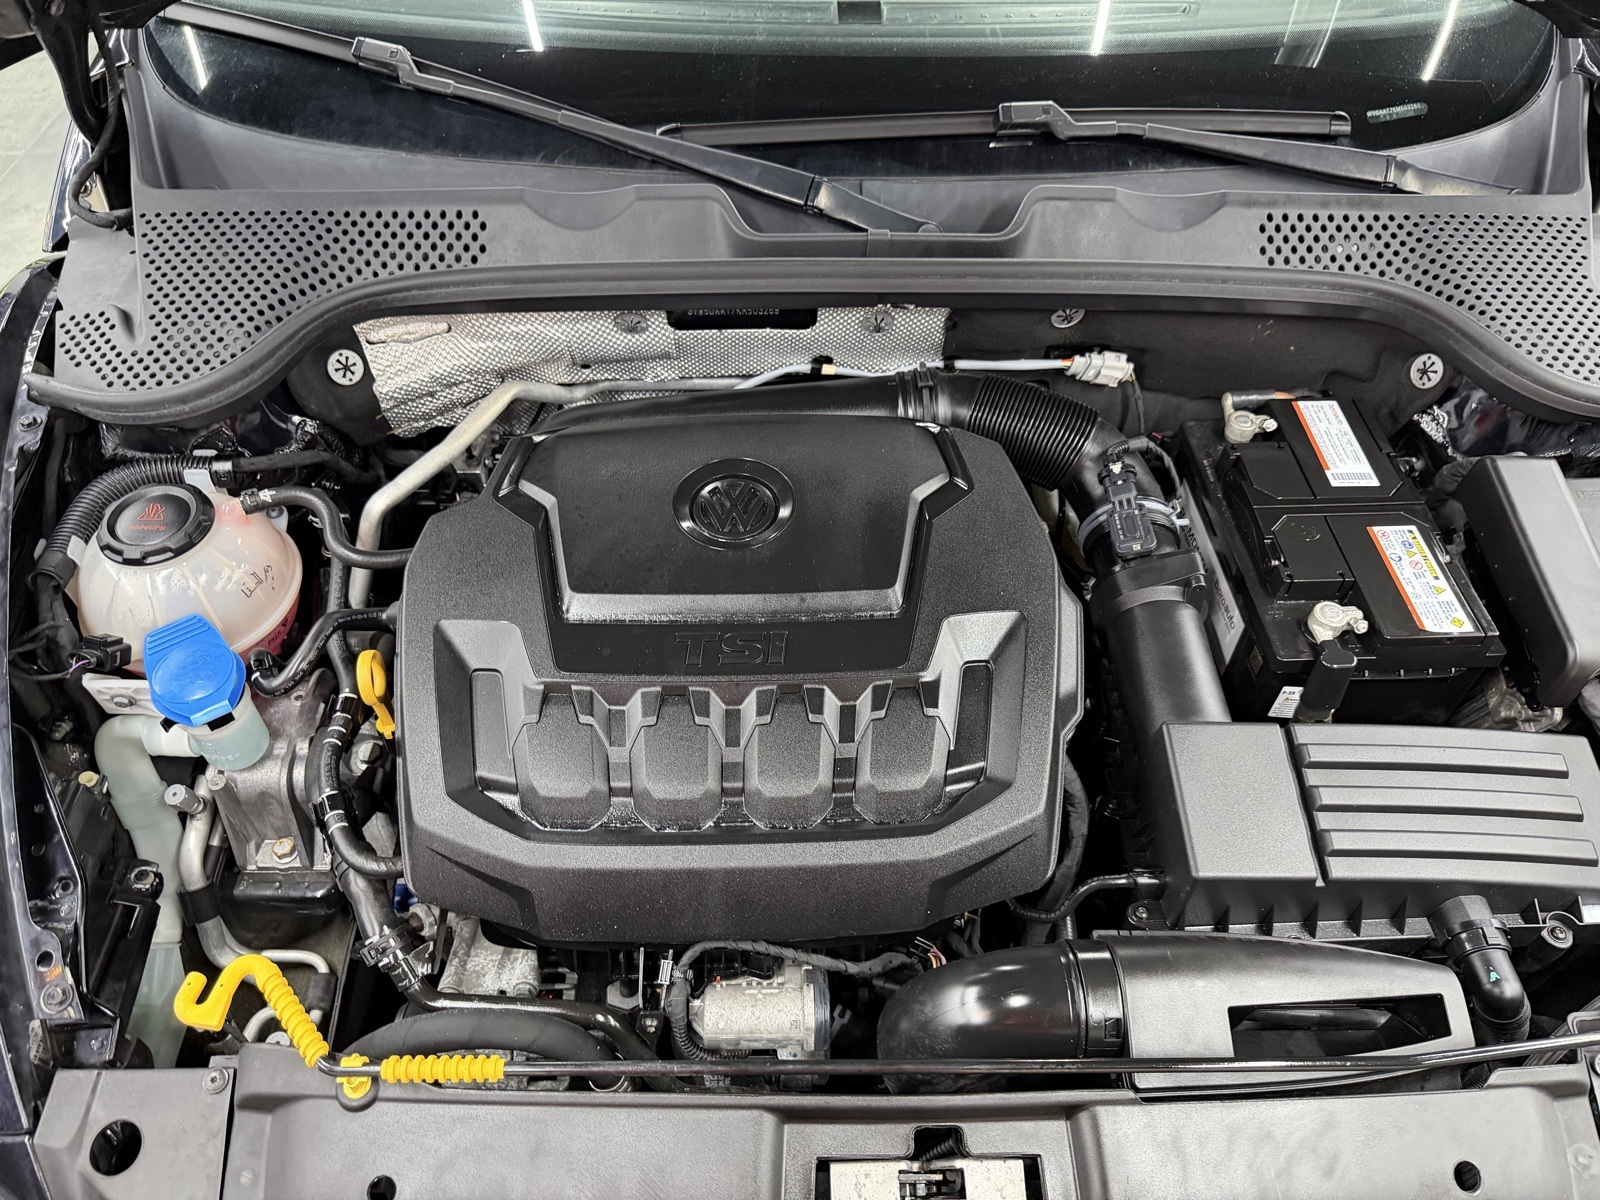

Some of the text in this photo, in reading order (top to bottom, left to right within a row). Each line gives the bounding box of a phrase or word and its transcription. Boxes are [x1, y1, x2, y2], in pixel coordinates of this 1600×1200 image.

[1213, 577, 1236, 631] bproauto
[267, 630, 281, 645] min
[674, 630, 789, 667] TSI
